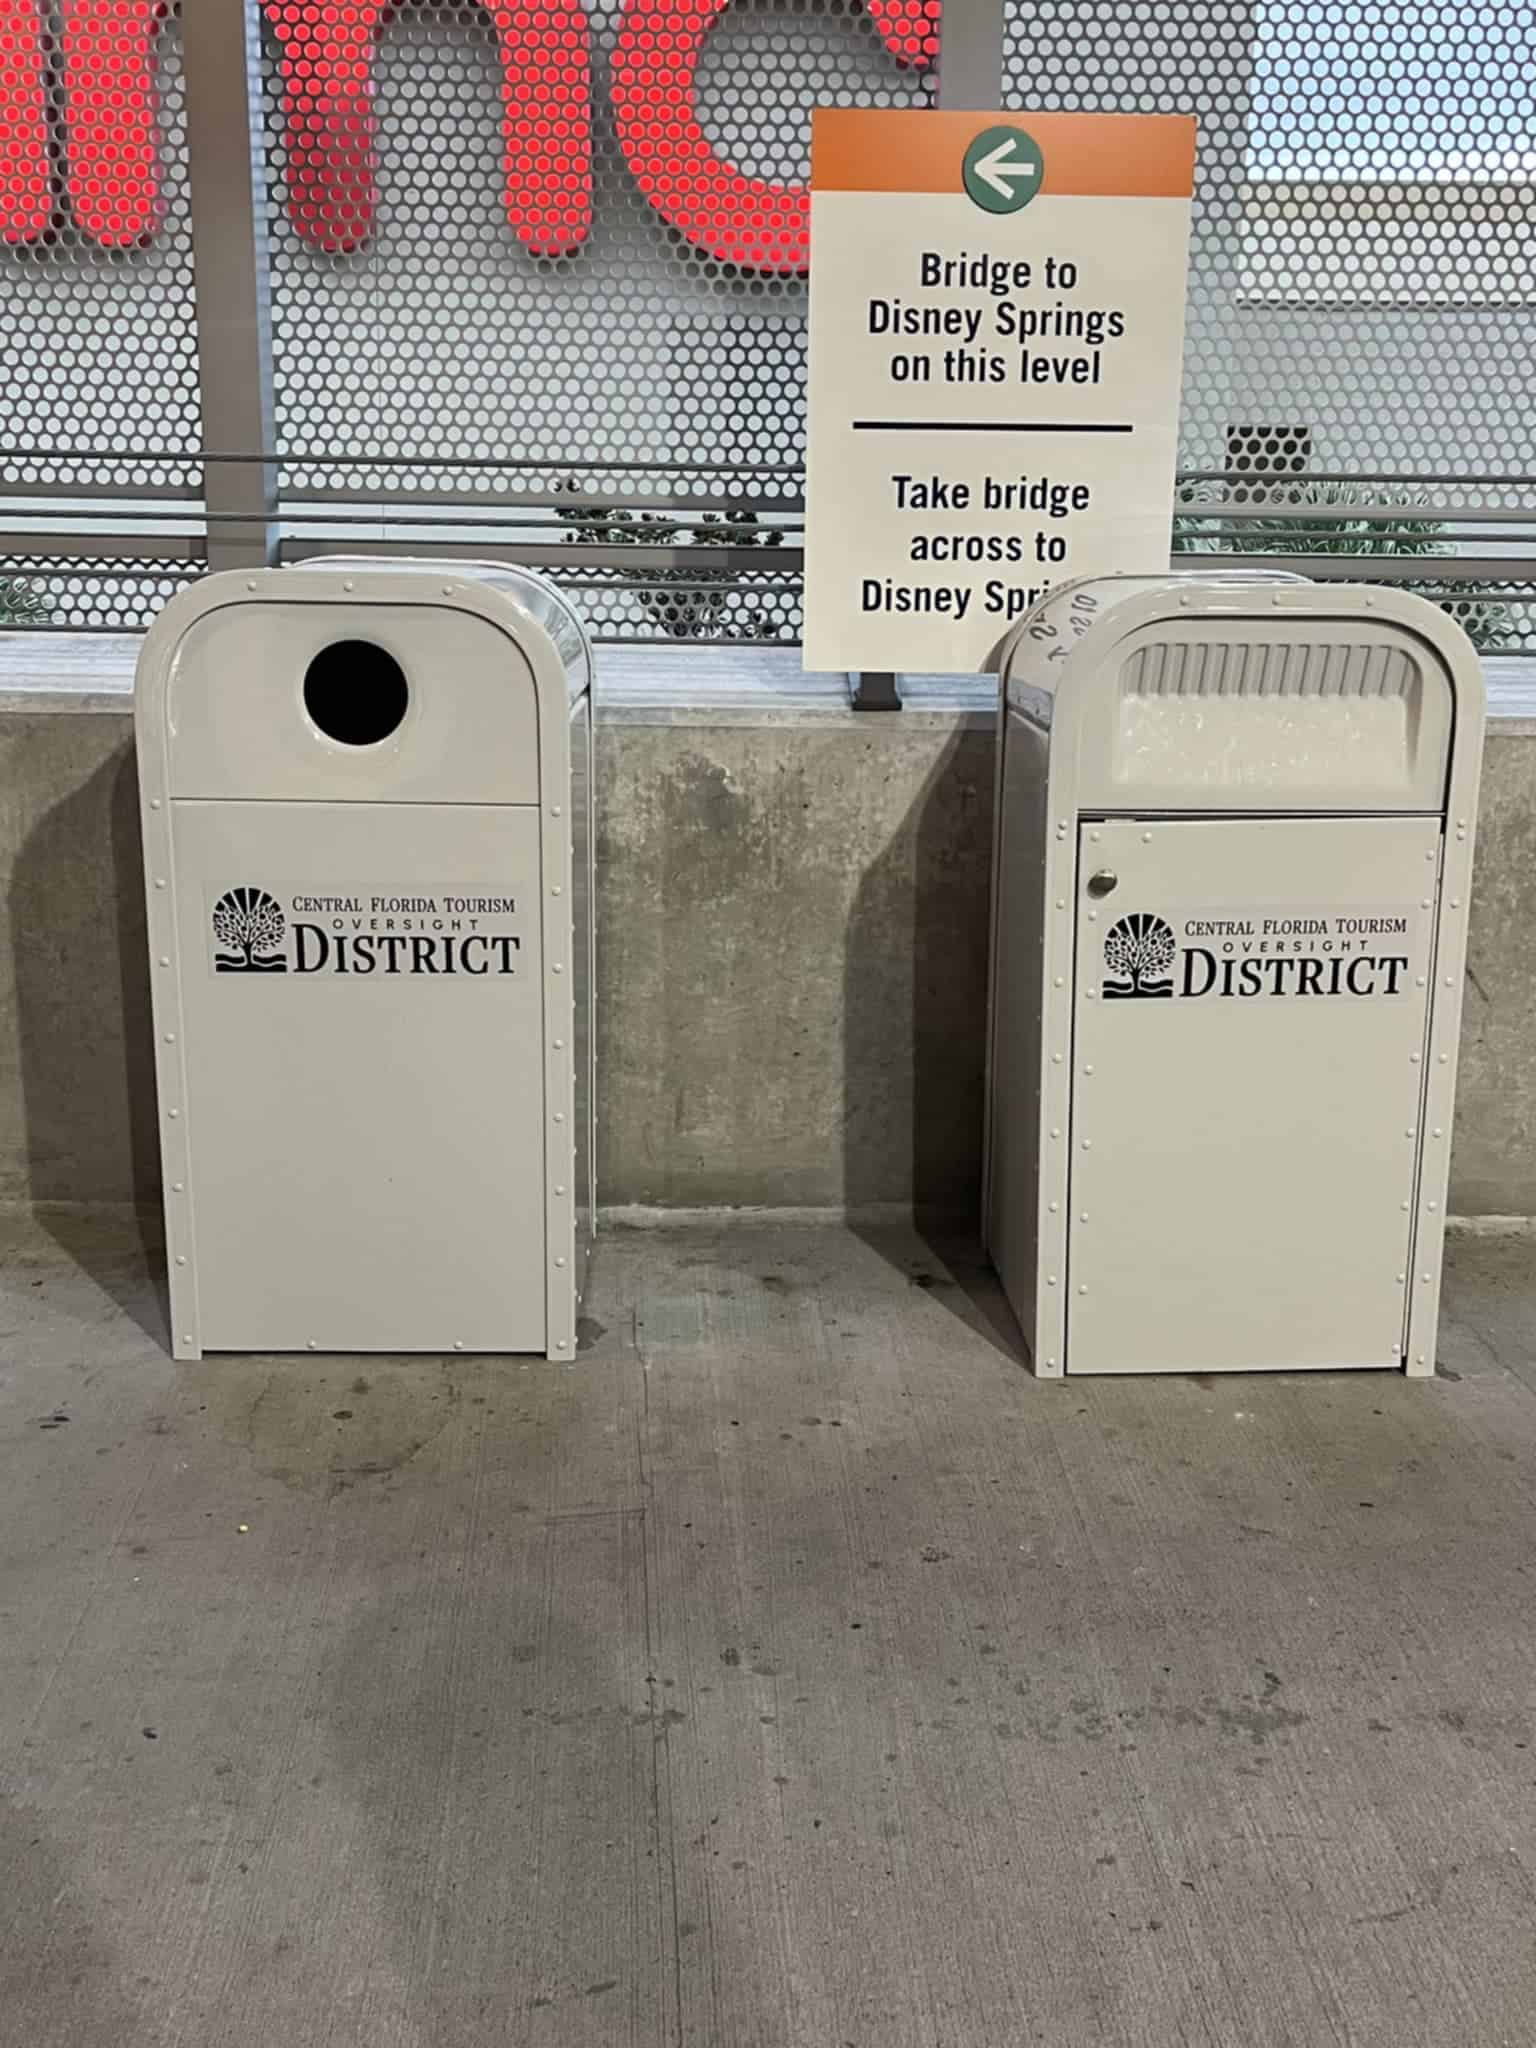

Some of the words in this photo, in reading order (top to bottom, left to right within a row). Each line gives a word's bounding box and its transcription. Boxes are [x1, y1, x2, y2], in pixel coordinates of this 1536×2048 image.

[921, 252, 1031, 294] Bridge
[1045, 257, 1077, 288] to
[869, 299, 982, 343] Disney
[996, 301, 1124, 344] Springs
[891, 354, 930, 382] on
[944, 348, 1006, 382] this
[1021, 350, 1100, 384] level
[892, 475, 970, 510] Take
[984, 476, 1090, 517] bridge
[910, 534, 1022, 562] across
[1036, 531, 1066, 562] to
[862, 579, 971, 620] Disney
[332, 918, 479, 930] OVERSIGHT
[1222, 940, 1369, 953] OVERSIGHT
